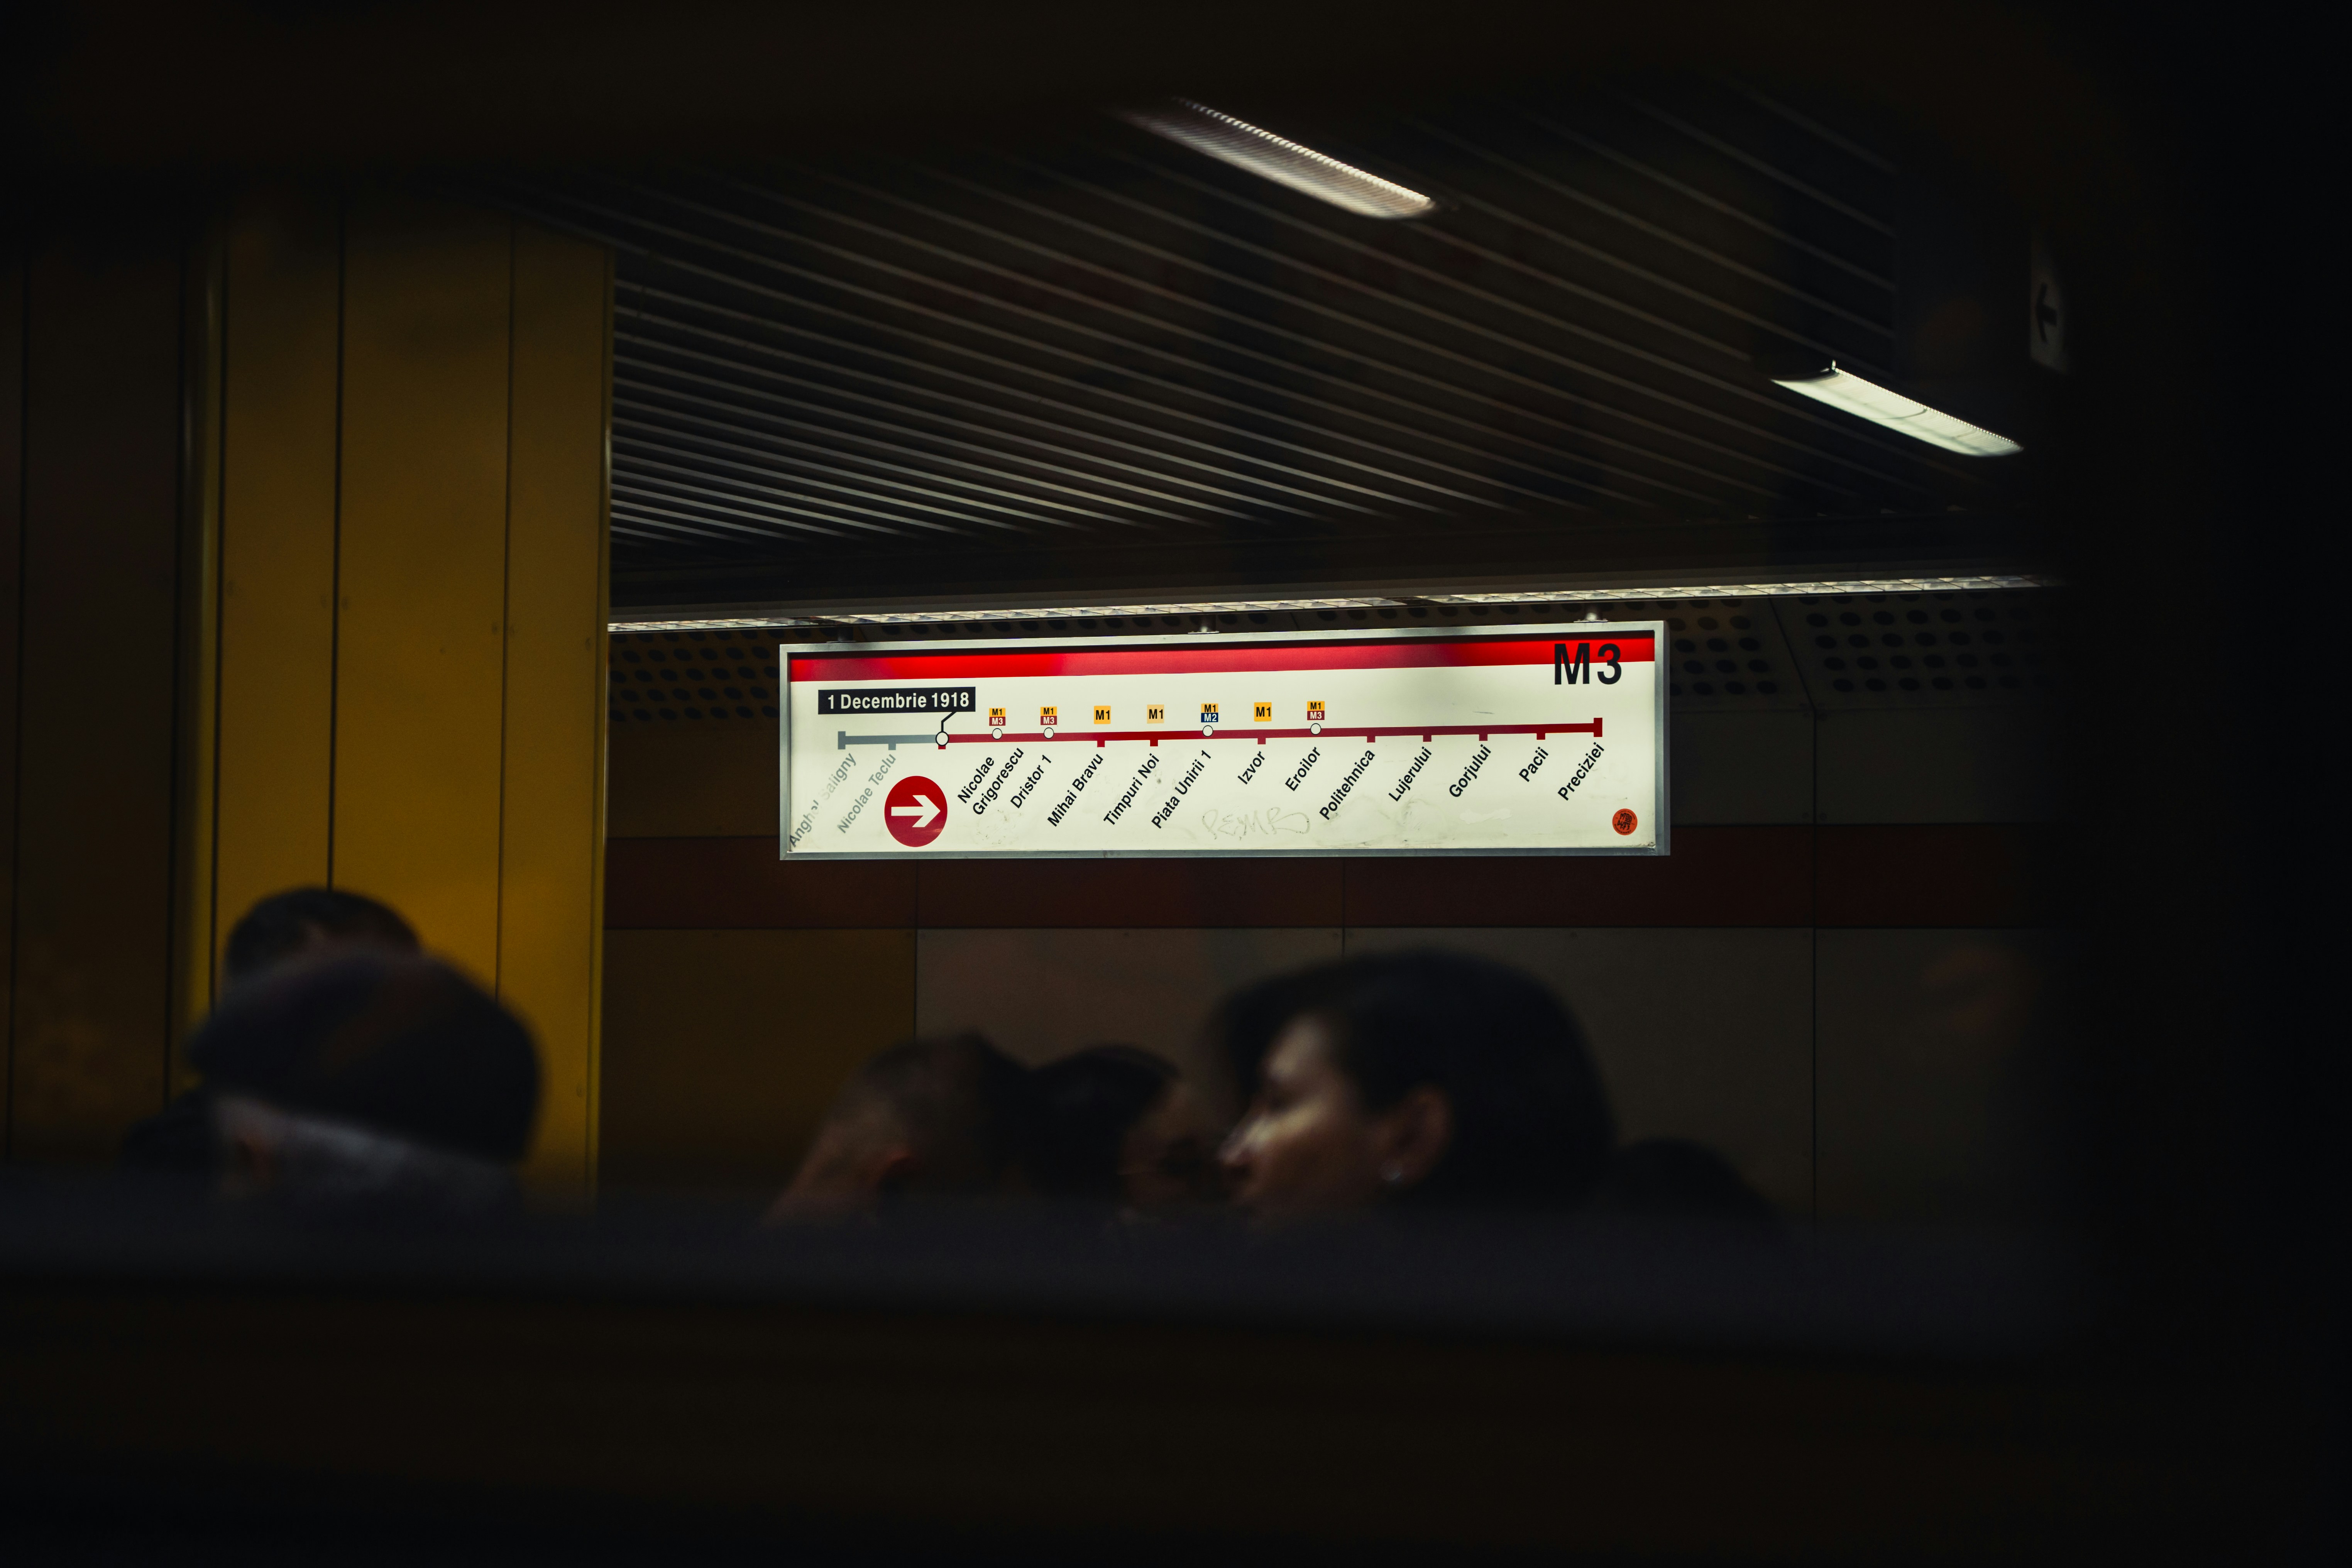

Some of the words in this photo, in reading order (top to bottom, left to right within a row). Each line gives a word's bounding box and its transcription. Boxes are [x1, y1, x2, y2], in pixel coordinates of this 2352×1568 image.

[1554, 643, 1622, 685] M3
[827, 695, 834, 709] 1
[841, 693, 927, 709] Decembrie
[932, 692, 970, 707] 1918
[1095, 709, 1110, 720] M1
[1149, 709, 1164, 719] M1
[1204, 704, 1216, 712] M1
[1204, 714, 1217, 722] M2
[1256, 707, 1271, 717] M1
[1310, 702, 1322, 710] M1
[1310, 711, 1322, 719] M3
[957, 756, 995, 803] Nicolae
[973, 748, 1024, 815] Grigorescu
[1010, 765, 1044, 809] Dristor
[1042, 754, 1052, 765] 1
[1237, 751, 1266, 785] Izvor
[1285, 747, 1321, 792] Eroilor
[1319, 750, 1375, 821] Politehnica
[1388, 746, 1432, 802] Lujerului
[1449, 744, 1491, 798] Gorjului
[1519, 747, 1548, 782] Pacii
[1557, 742, 1604, 801] Preciziei
[837, 787, 873, 834] Nicolae
[868, 753, 896, 788] Teclu
[1047, 790, 1077, 827] Mihai
[1072, 754, 1103, 792] Bravu
[1103, 777, 1143, 825] Timpuri
[1137, 753, 1159, 779] Noi
[1151, 796, 1180, 829] Piata
[1174, 759, 1205, 795] Unirii
[1201, 750, 1211, 760] 1
